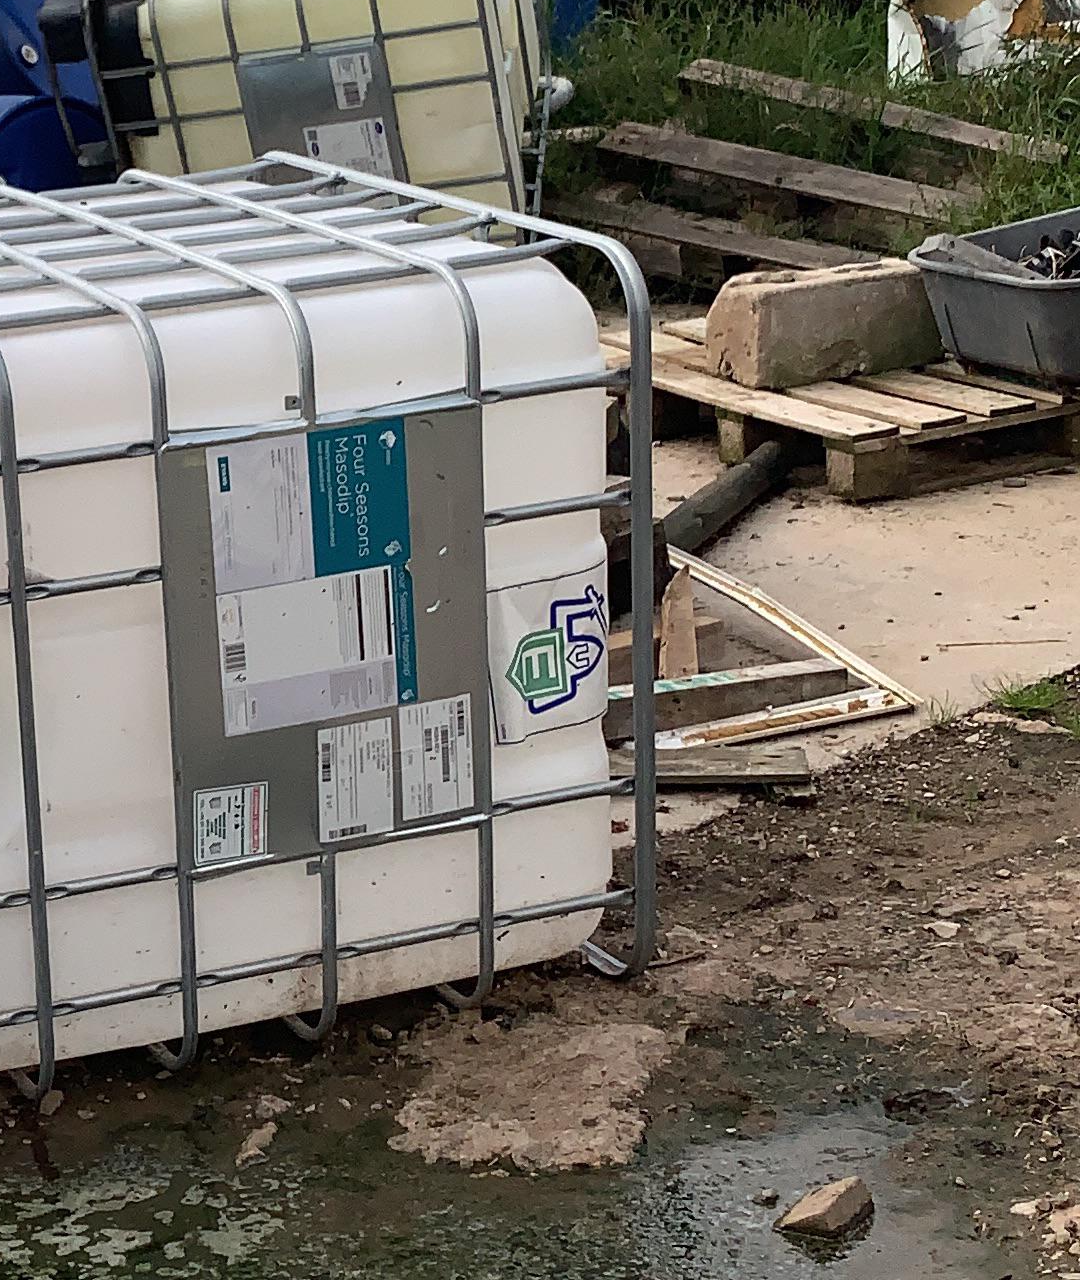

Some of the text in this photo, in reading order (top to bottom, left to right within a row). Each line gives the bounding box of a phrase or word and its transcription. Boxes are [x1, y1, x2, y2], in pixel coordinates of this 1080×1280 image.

[334, 436, 351, 514] Masodip
[352, 434, 370, 557] Four Seasons
